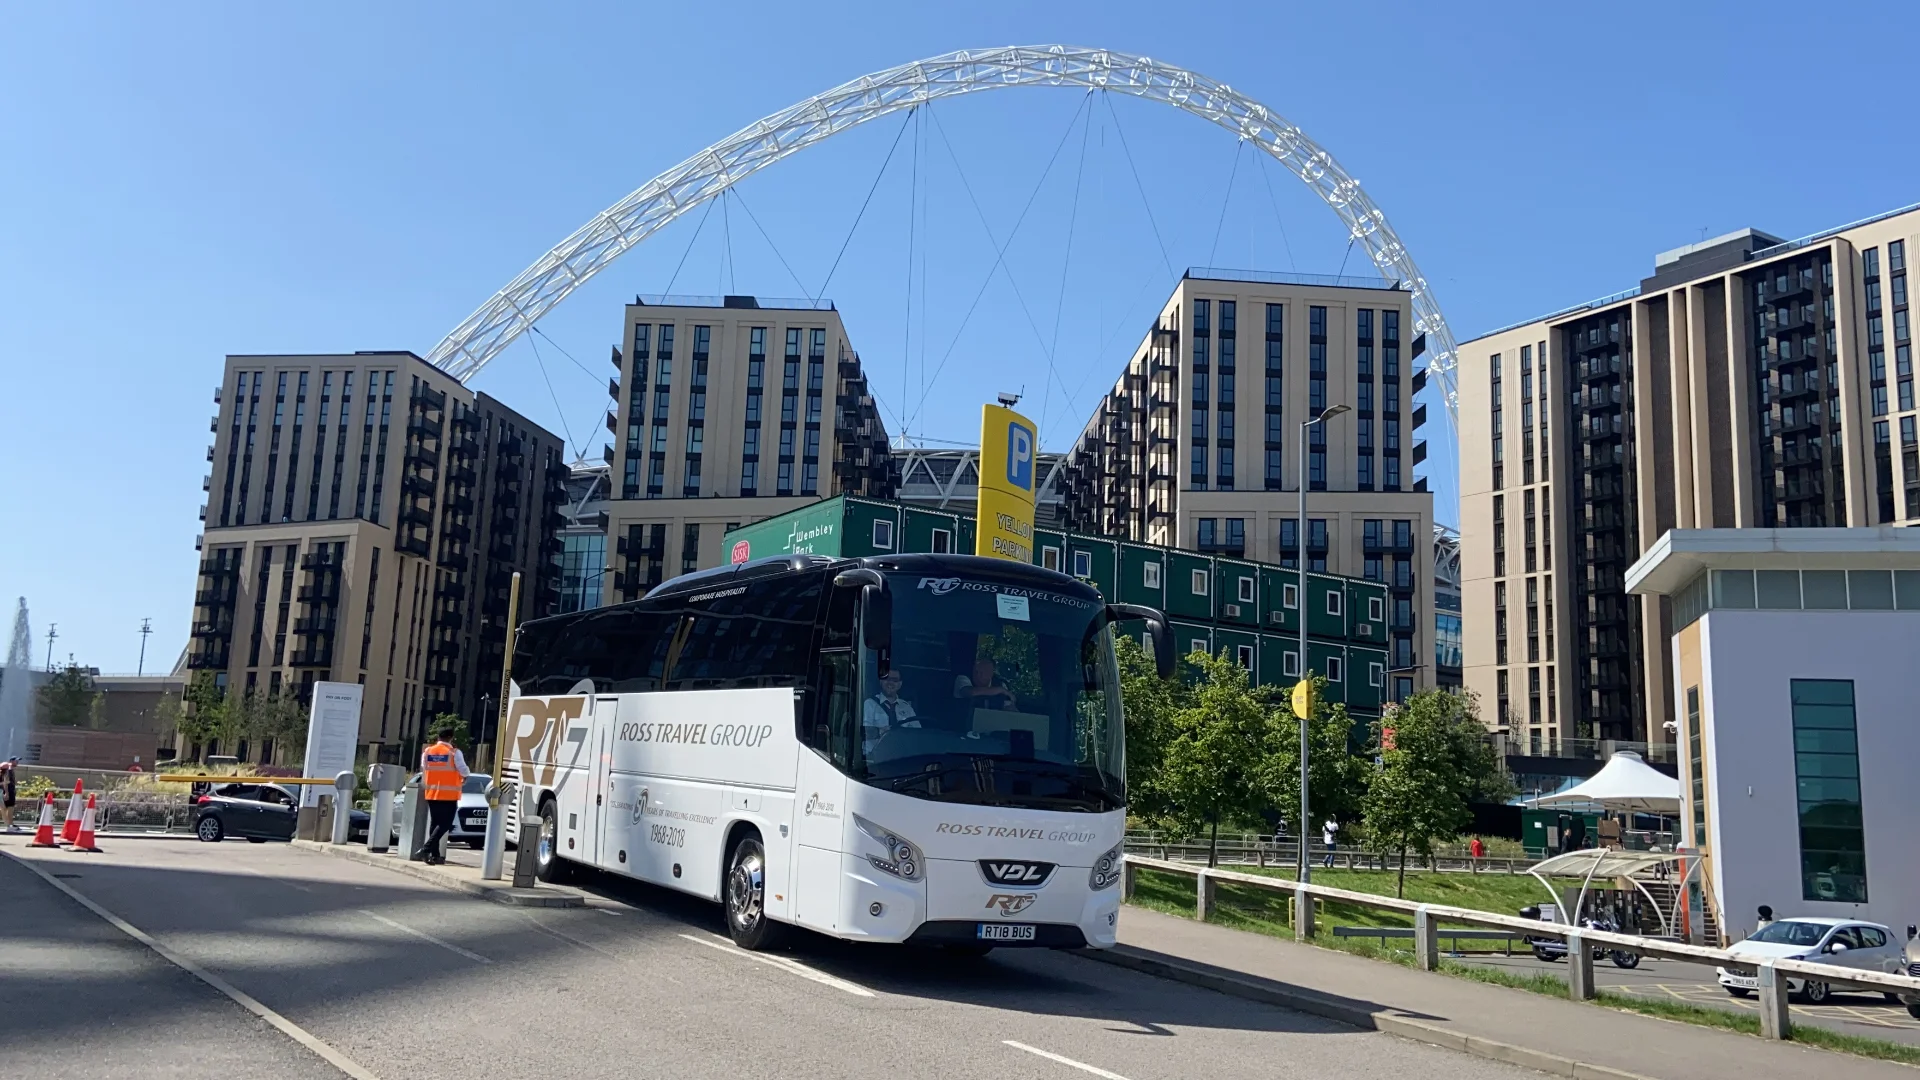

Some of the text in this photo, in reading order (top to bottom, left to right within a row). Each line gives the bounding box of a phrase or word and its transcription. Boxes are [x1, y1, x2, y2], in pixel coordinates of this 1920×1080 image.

[1012, 427, 1031, 477] P
[796, 524, 834, 543] Wembley
[733, 546, 748, 562] SISK
[715, 586, 747, 598] HOSPITALITY
[962, 582, 998, 593] ROSS
[1003, 586, 1049, 601] TRAVEL
[1052, 595, 1090, 610] GROUP
[619, 722, 772, 748] ROSS TRAVEL GROUP
[650, 823, 686, 848] 1968-2018
[936, 823, 1096, 843] ROSS TRAVEL GROUP
[989, 863, 1042, 880] VDL
[985, 925, 1033, 938] RT18 BUS
